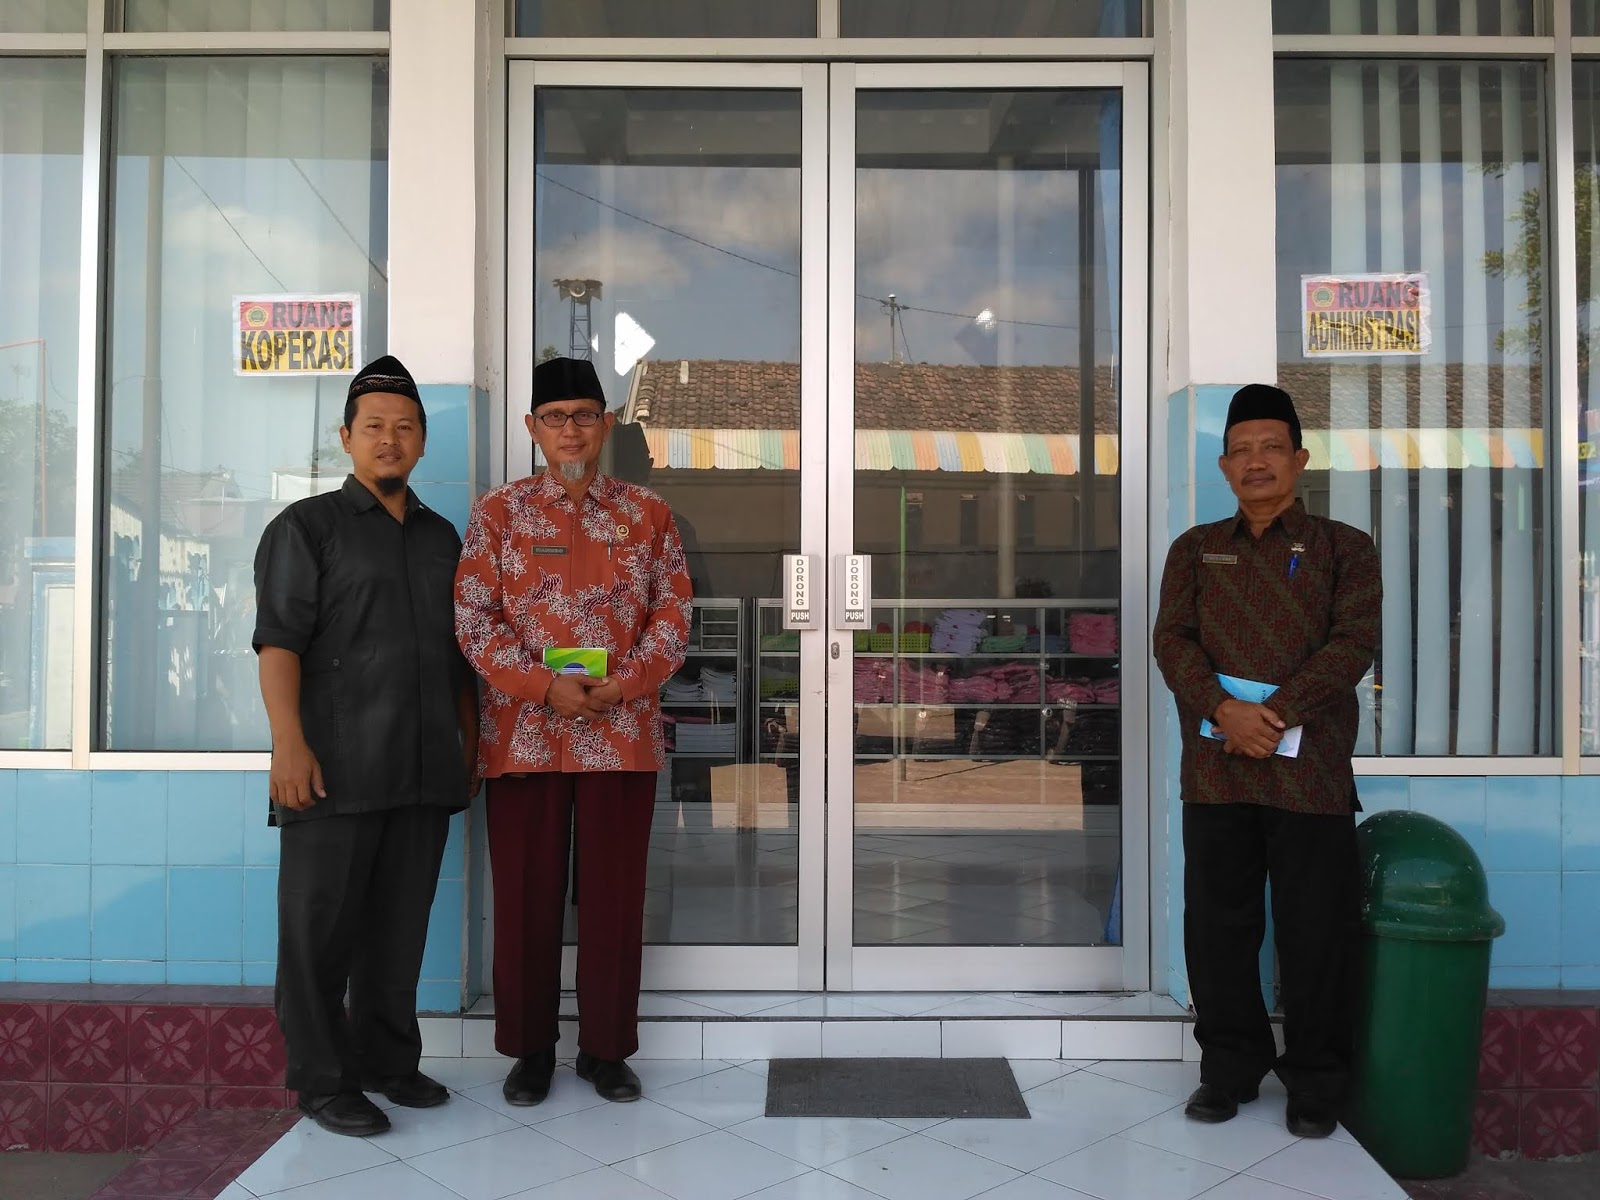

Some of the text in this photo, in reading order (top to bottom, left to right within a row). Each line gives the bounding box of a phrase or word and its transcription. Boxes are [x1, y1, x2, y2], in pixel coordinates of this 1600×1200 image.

[1338, 281, 1419, 308] RUANG
[272, 302, 353, 328] RUANG
[1308, 310, 1420, 350] ADMINISTRASI
[241, 330, 353, 370] KOPERASI
[796, 559, 804, 605] DORONG
[850, 559, 859, 605] DORONG
[791, 611, 809, 620] PUSH
[845, 611, 864, 620] PUSH
